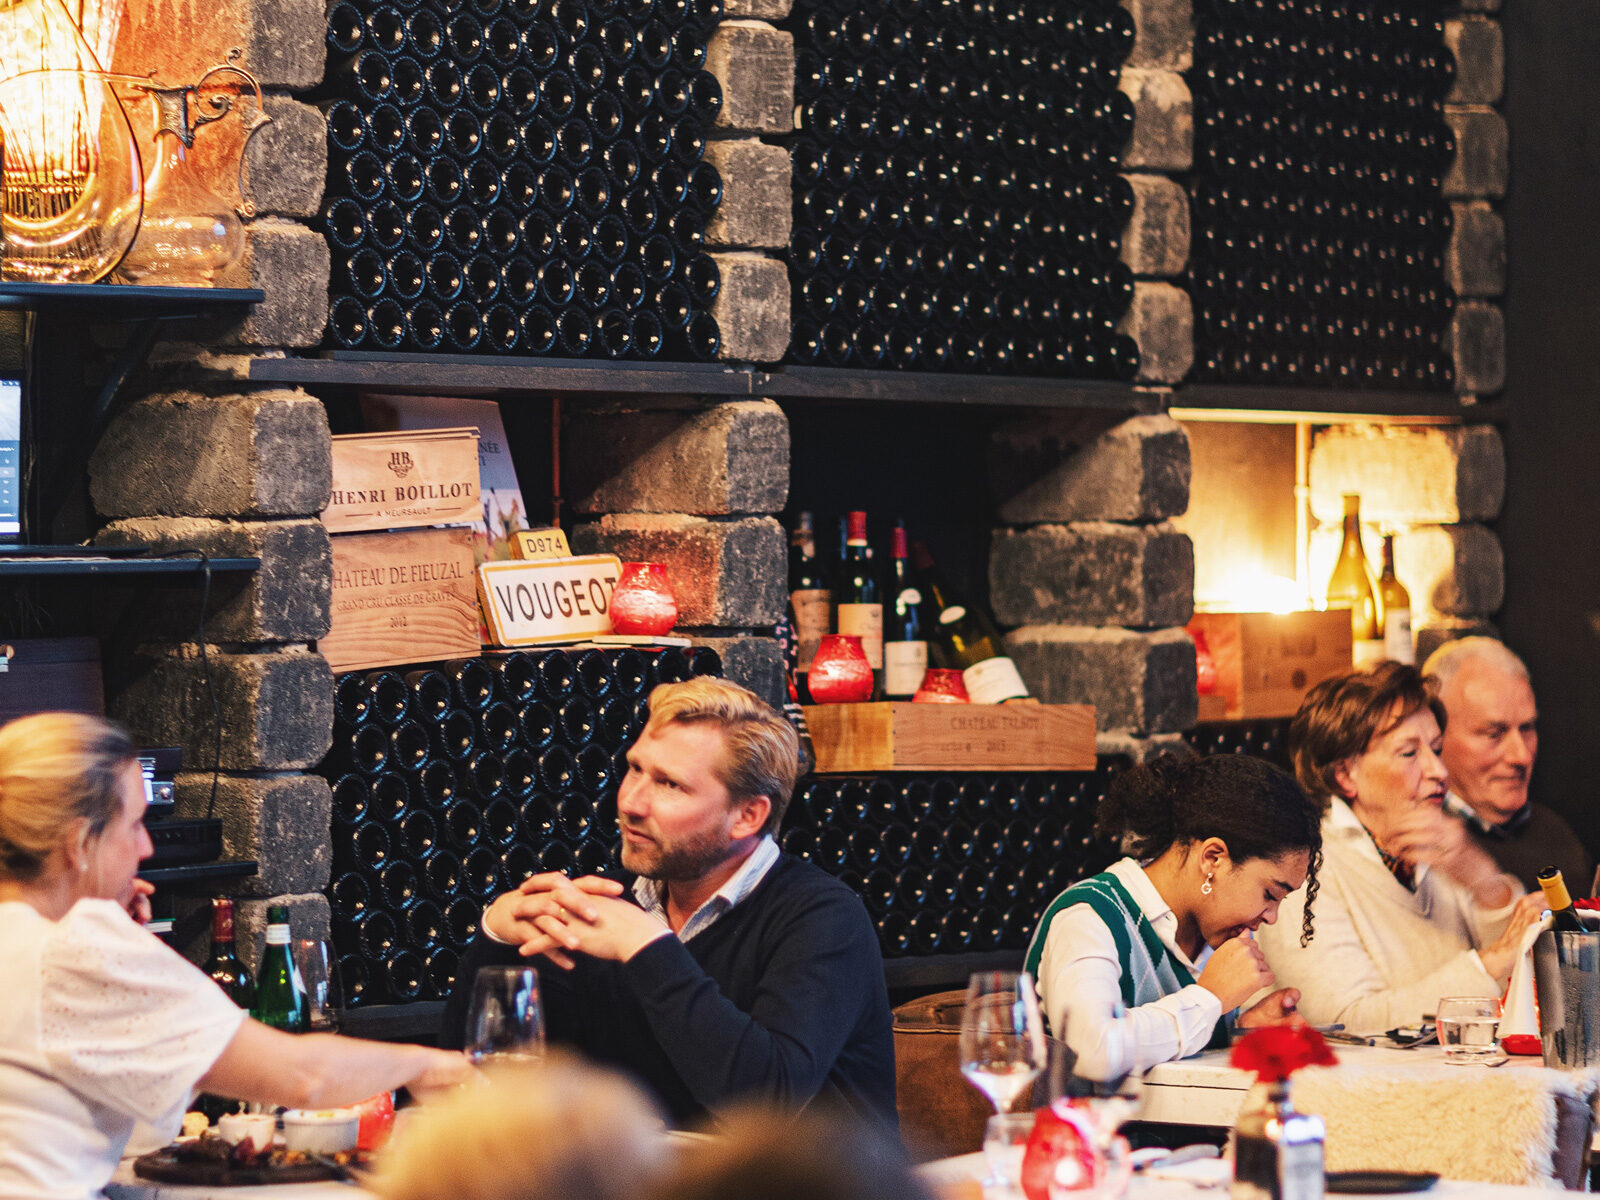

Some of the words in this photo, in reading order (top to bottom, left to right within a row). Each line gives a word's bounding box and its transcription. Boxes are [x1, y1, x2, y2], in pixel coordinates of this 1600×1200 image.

[391, 451, 411, 465] HB
[332, 489, 386, 505] HENRI
[395, 482, 473, 501] BOILLOT
[384, 507, 431, 518] MEURSAULT
[527, 538, 563, 553] D974
[333, 567, 386, 589] HATEAU
[390, 566, 408, 585] DE
[410, 561, 465, 583] FIEUZAL
[336, 599, 365, 612] GRAND
[414, 593, 424, 605] DE
[495, 577, 617, 622] VOUGEOT
